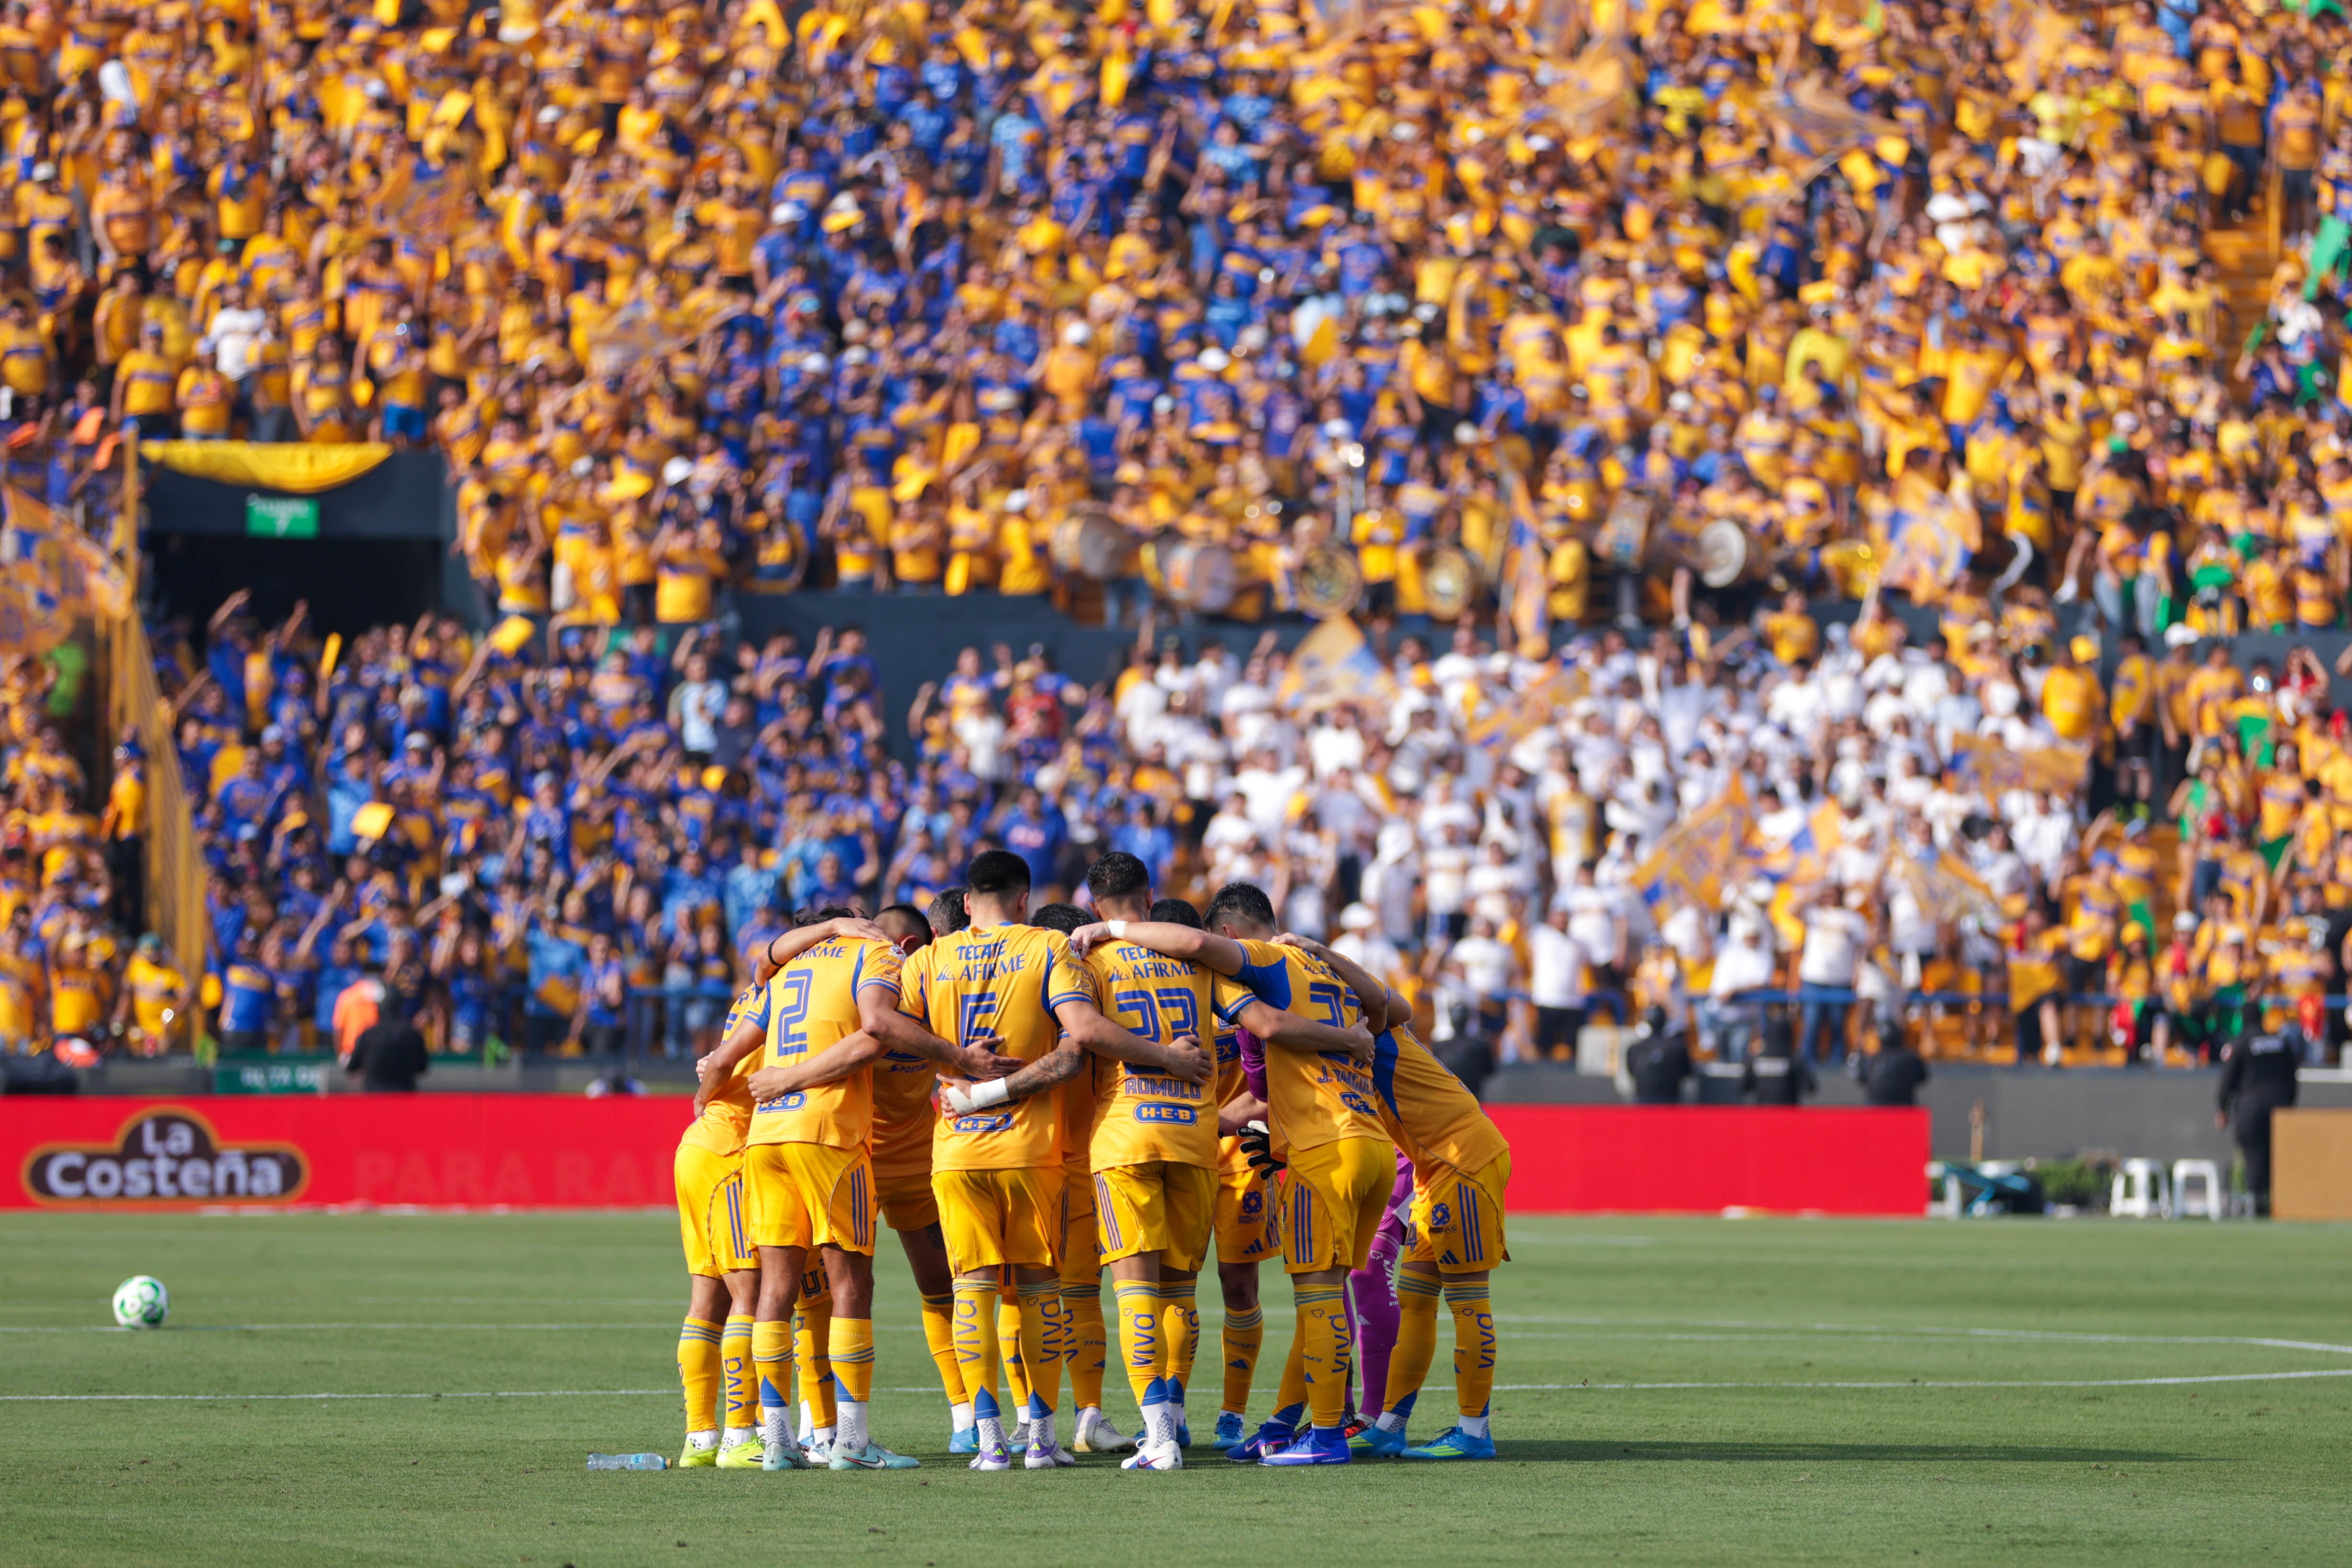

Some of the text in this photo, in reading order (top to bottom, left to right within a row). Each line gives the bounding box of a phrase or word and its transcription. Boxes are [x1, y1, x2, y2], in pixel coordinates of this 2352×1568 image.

[955, 939, 1009, 961] TECATE
[959, 954, 1025, 981] AFIRME
[1133, 959, 1197, 979] AFIRME
[777, 968, 814, 1057] 2
[1125, 1077, 1202, 1099] ROMULO
[1141, 1107, 1191, 1120] H-E-B
[142, 1116, 193, 1155] La
[45, 1148, 284, 1198] Costeña
[356, 1150, 535, 1201] PARA
